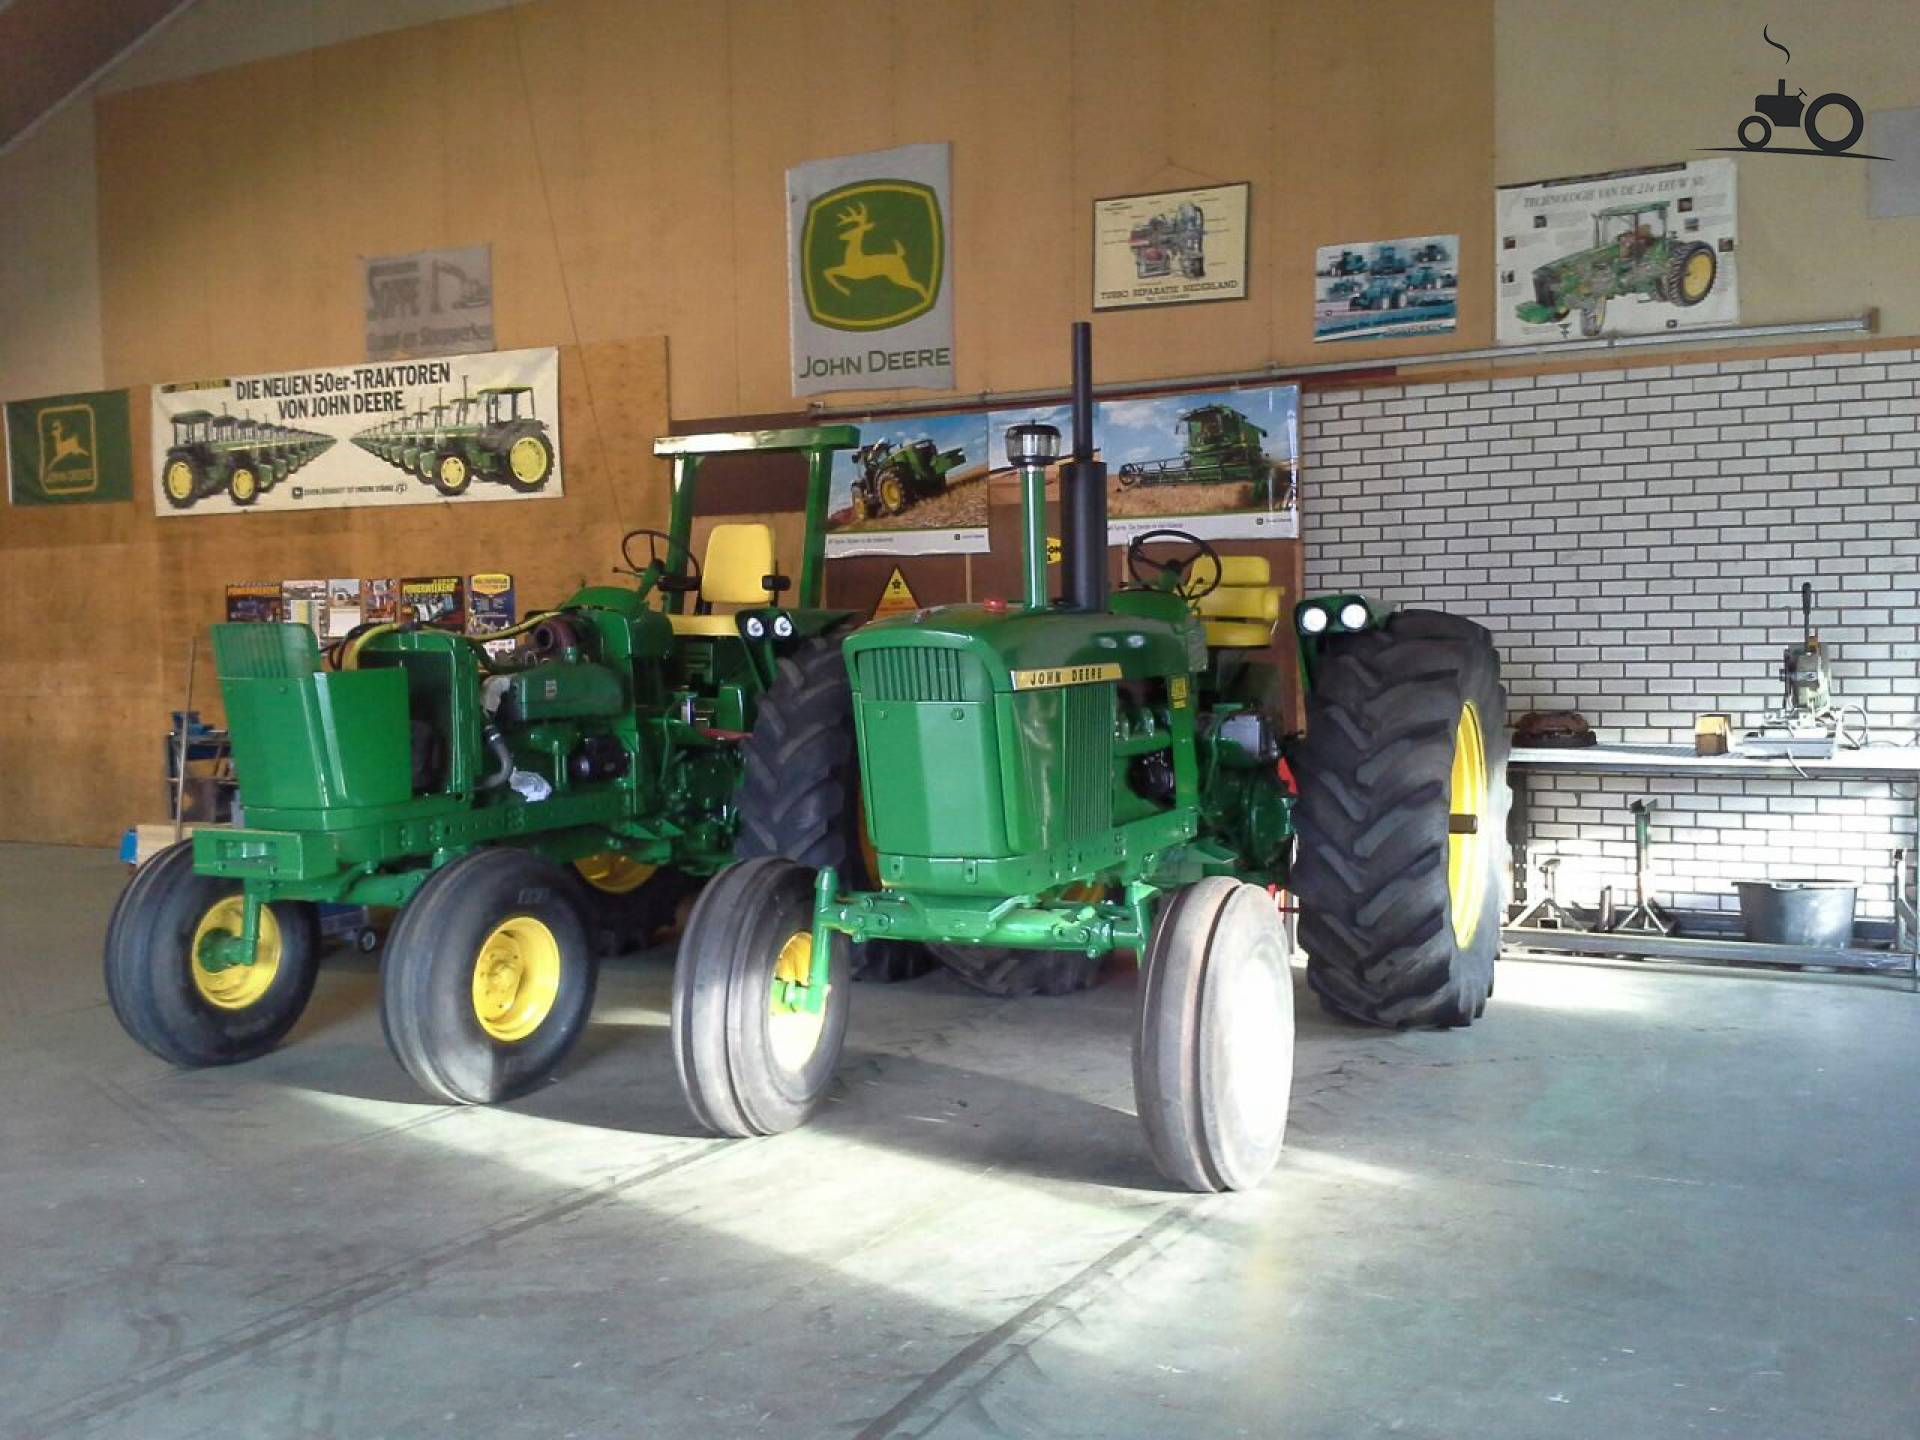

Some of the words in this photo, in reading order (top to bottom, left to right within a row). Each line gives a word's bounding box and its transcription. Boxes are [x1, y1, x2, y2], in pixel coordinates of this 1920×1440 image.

[799, 356, 862, 379] JOHN
[868, 348, 951, 373] DEERE
[236, 380, 260, 400] DIE
[262, 374, 312, 398] NEUEN
[314, 362, 451, 394] 50er-TRAKTOREN
[278, 399, 307, 420] VON
[311, 395, 350, 418] JOHN
[354, 390, 405, 415] DEERE
[1031, 671, 1061, 687] JOHN
[1072, 667, 1102, 682] DEERE
